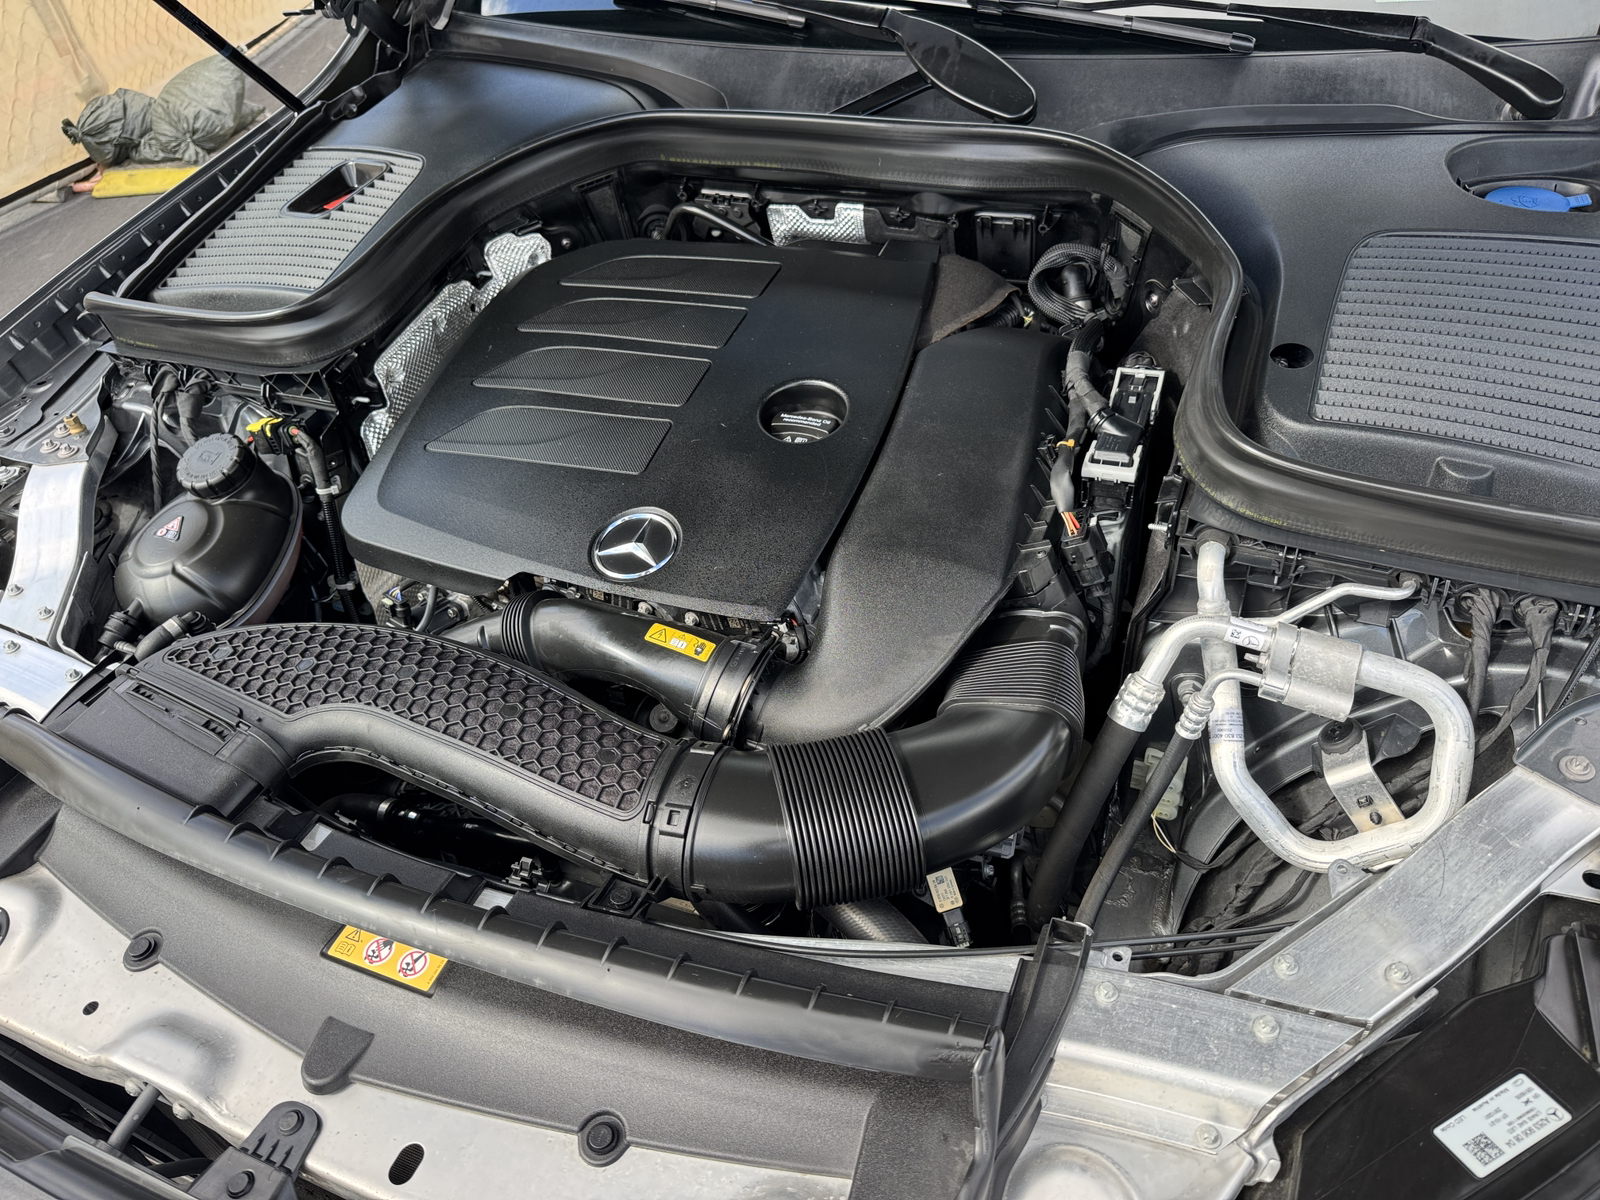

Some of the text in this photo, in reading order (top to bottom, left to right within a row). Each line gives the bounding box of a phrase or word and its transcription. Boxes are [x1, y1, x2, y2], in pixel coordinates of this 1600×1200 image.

[780, 413, 822, 422] Mercedes-Benz
[783, 418, 821, 426] recommended
[1494, 1087, 1509, 1098] Made
[1471, 1099, 1489, 1112] Austria
[1439, 1114, 1466, 1133] LED Code
[1531, 1115, 1551, 1130] A253
[1506, 1125, 1518, 1134] LED
